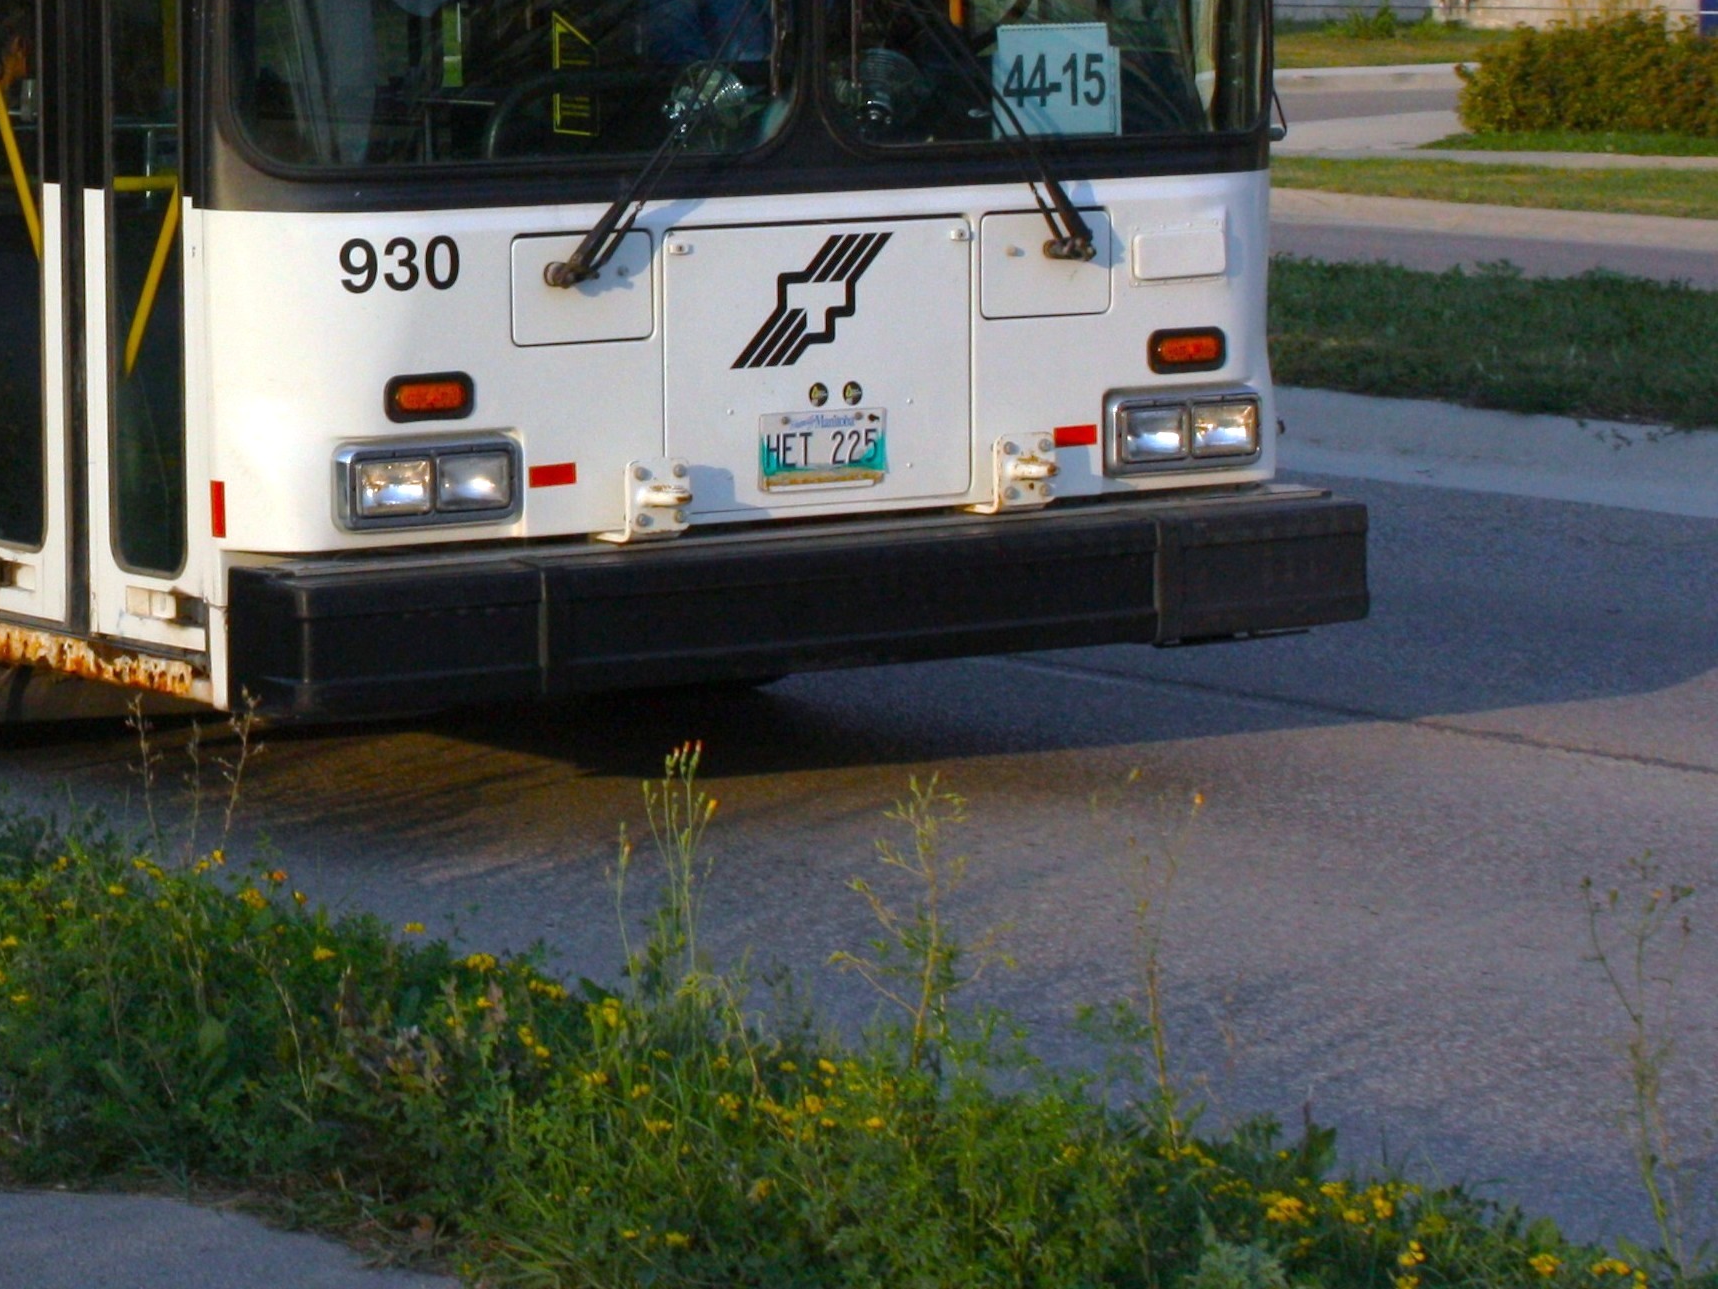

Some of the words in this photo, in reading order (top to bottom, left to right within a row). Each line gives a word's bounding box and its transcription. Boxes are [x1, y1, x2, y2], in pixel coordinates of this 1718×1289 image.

[1002, 52, 1106, 108] 44-15
[339, 234, 461, 295] 930
[766, 431, 814, 469] HET
[830, 428, 879, 465] 225
